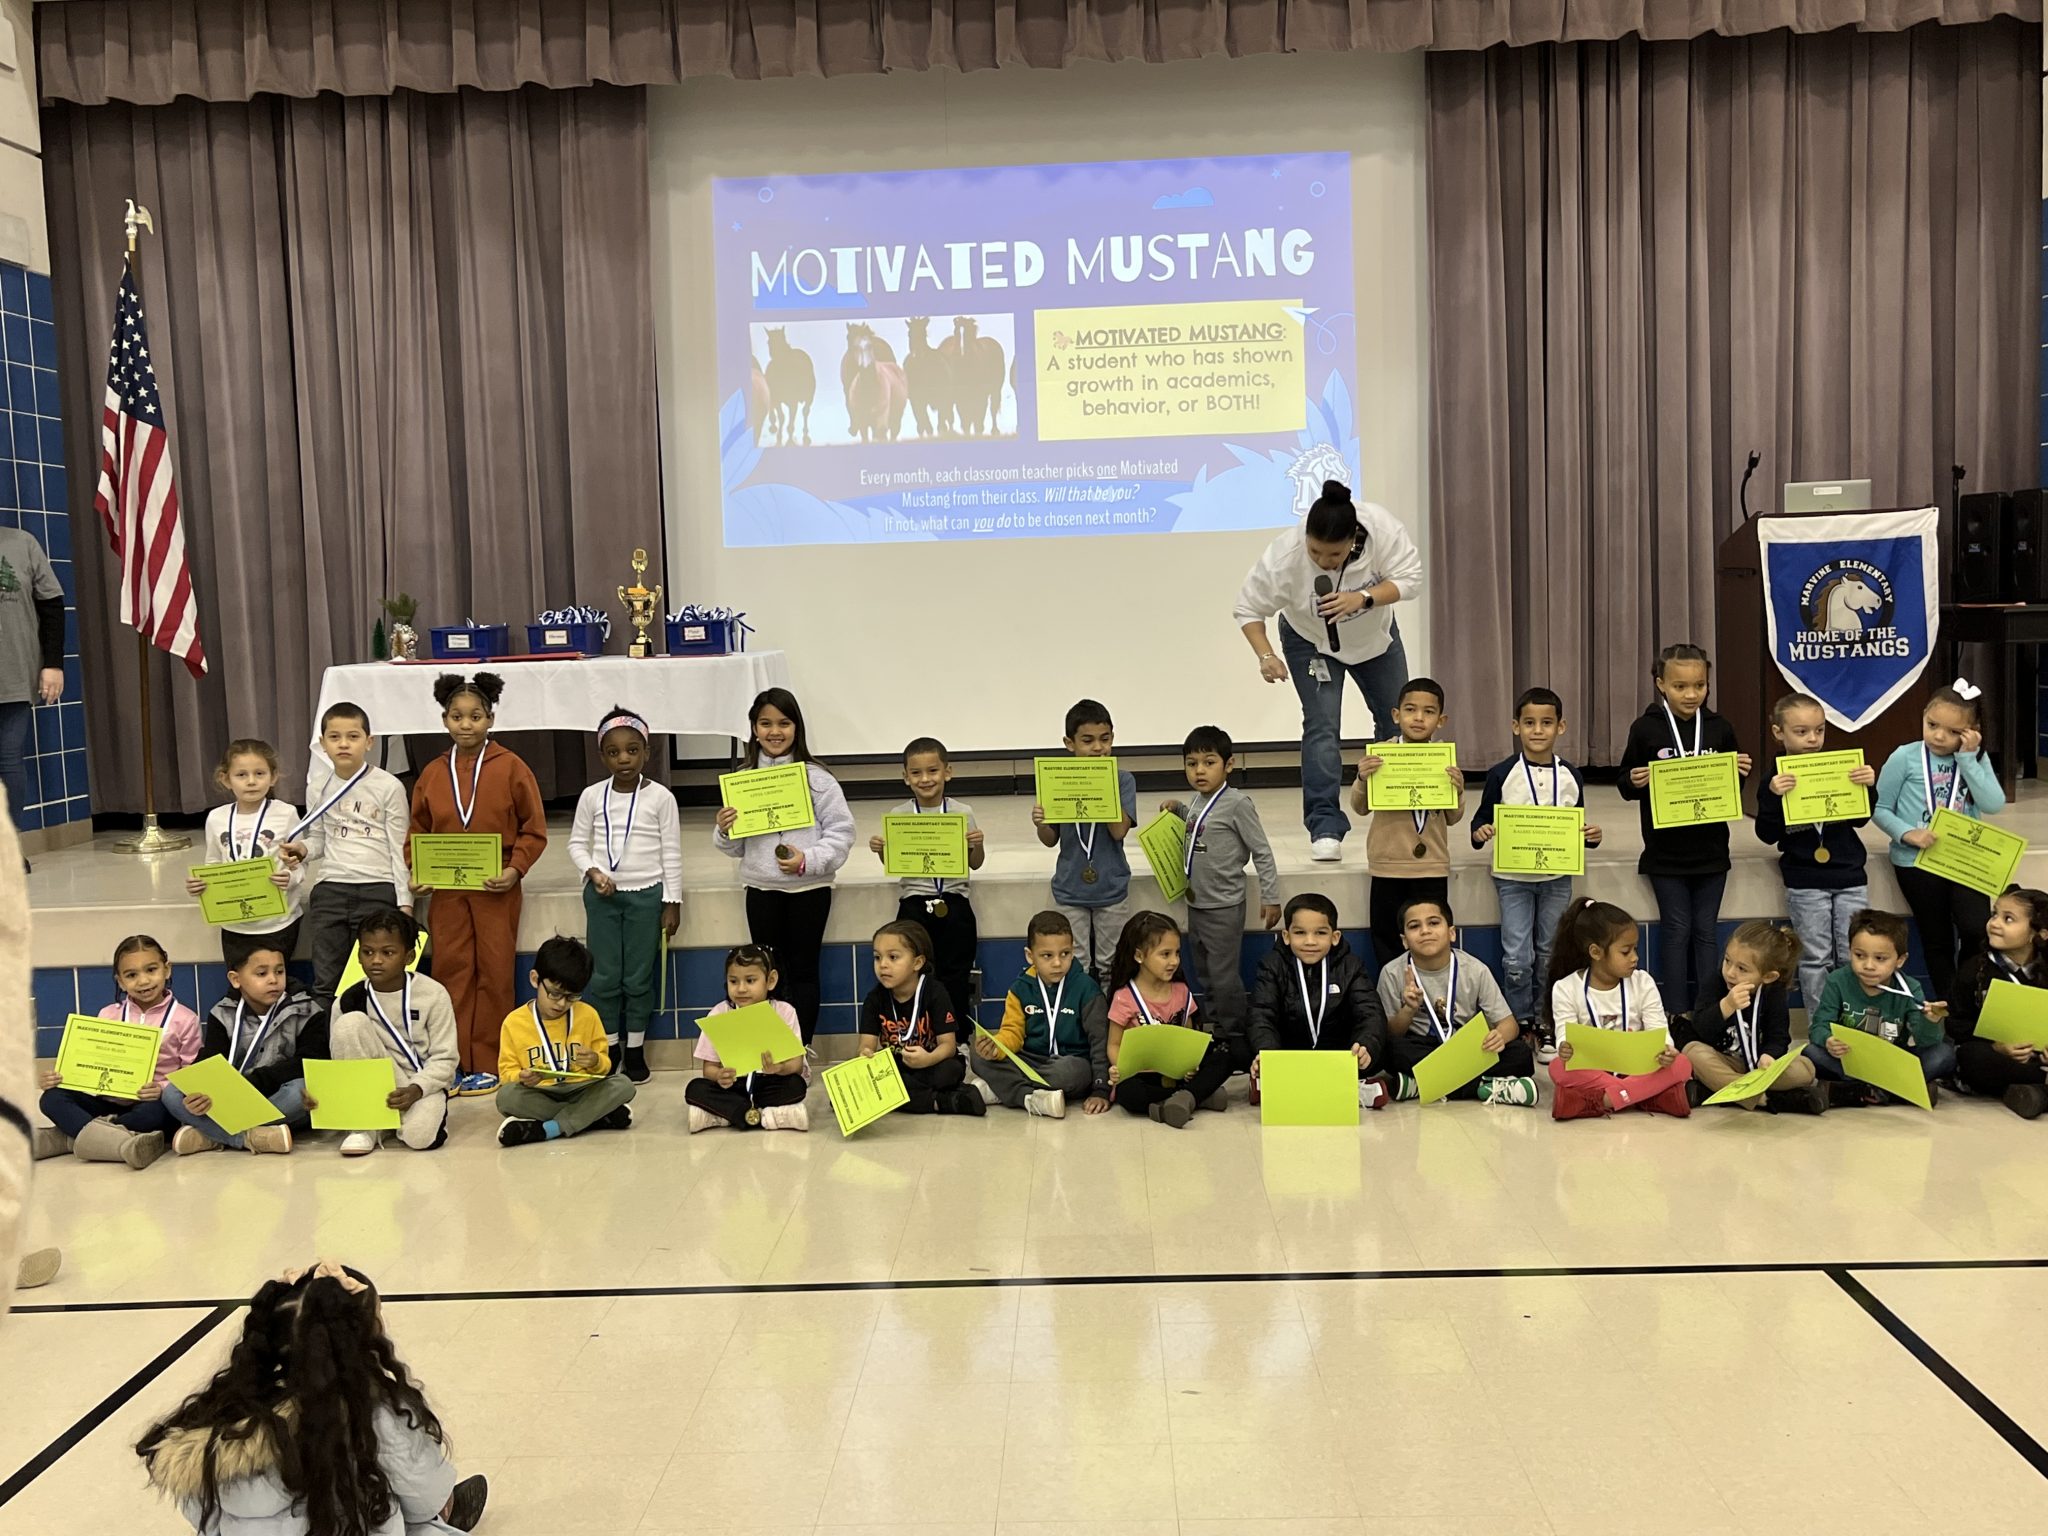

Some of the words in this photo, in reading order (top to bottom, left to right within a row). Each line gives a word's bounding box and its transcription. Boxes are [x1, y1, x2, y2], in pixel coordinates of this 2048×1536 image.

[751, 240, 1045, 297] MOTIVATED
[1067, 228, 1315, 285] MUSTANG
[1075, 327, 1181, 347] MOTIVATED
[1189, 323, 1287, 342] MUSTANG:
[1046, 355, 1060, 371] A
[1068, 353, 1138, 370] student
[1145, 351, 1185, 367] who
[1193, 349, 1224, 366] has
[1232, 348, 1293, 364] shown
[1066, 376, 1134, 397] growth
[1142, 375, 1158, 391] in
[1166, 371, 1275, 390] academics,
[1082, 398, 1170, 416] behavior,
[1178, 397, 1199, 412] or
[1206, 394, 1260, 411] BOTH!
[860, 469, 891, 487] Every
[893, 467, 933, 484] month,
[935, 466, 961, 483] each
[963, 466, 1018, 482] classroom
[1022, 464, 1063, 480] teacher
[1066, 462, 1094, 480] picks
[1097, 465, 1117, 478] one
[1120, 458, 1178, 476] Motivated
[902, 492, 950, 510] Mustang
[953, 491, 979, 506] from
[982, 489, 1007, 505] their
[1010, 488, 1040, 504] class.
[1045, 486, 1067, 503] Will
[1068, 486, 1093, 502] that
[1094, 485, 1110, 501] be
[1110, 483, 1140, 503] you?
[885, 517, 895, 532] If
[920, 515, 948, 531] what
[951, 518, 970, 529] can
[973, 517, 994, 531] you
[997, 513, 1012, 528] do
[1013, 514, 1025, 528] to
[1028, 512, 1041, 527] be
[1044, 512, 1082, 527] chosen
[1085, 510, 1110, 525] next
[1113, 507, 1157, 524] month?
[1801, 564, 1832, 606] MARVINE
[1839, 560, 1894, 603] ELEMENTARY
[1796, 630, 1840, 643] HOME
[1845, 629, 1863, 642] OF
[1867, 626, 1897, 640] THE
[1789, 637, 1910, 661] MUSTANGS
